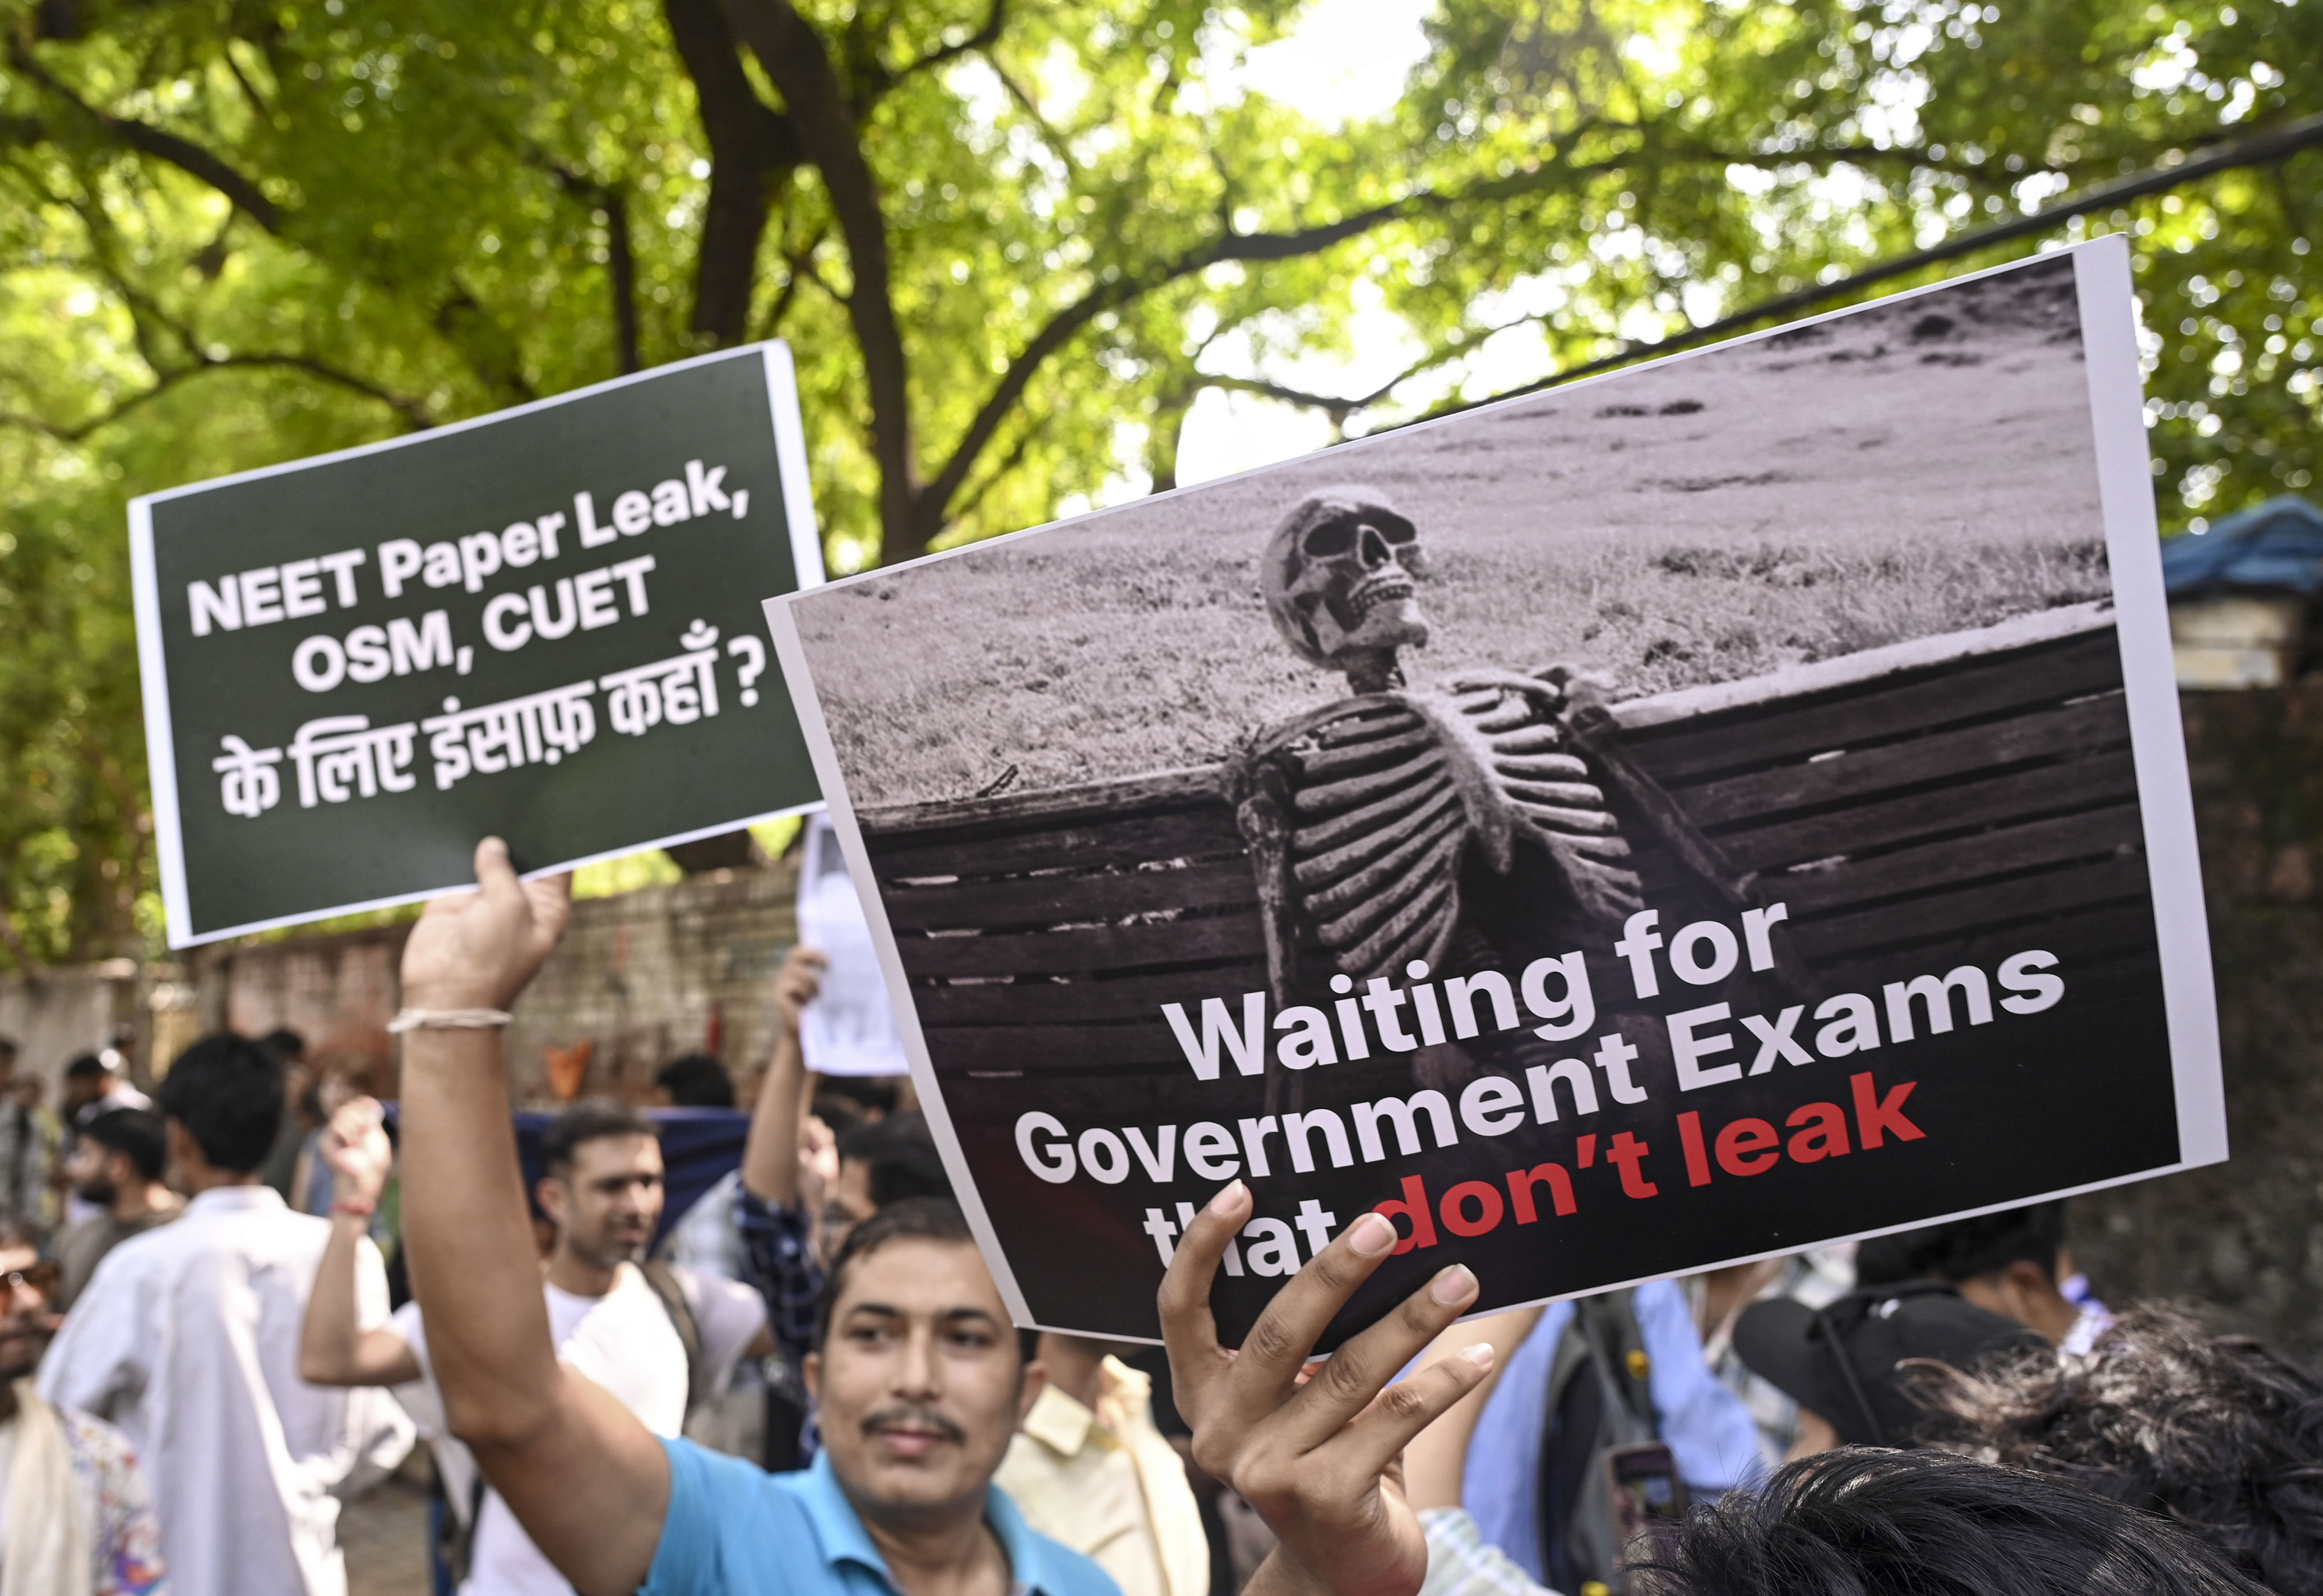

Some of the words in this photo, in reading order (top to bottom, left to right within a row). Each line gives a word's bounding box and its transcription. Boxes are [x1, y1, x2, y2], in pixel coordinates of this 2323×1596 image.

[188, 549, 365, 636] NEET
[378, 512, 565, 598] Paper
[575, 460, 749, 548] Leak,
[293, 610, 473, 692] OSM,
[483, 555, 655, 650] CUET
[212, 735, 283, 817] के
[287, 715, 417, 808] लिए
[599, 619, 719, 735] कहाँ
[728, 635, 765, 707] ?
[1016, 1033, 1648, 1183] Government
[1666, 950, 2063, 1091] Exams
[1160, 951, 1595, 1080] Waiting
[1614, 903, 1788, 998] for
[1372, 1132, 1658, 1255] don’t
[1677, 1072, 1926, 1186] leak
